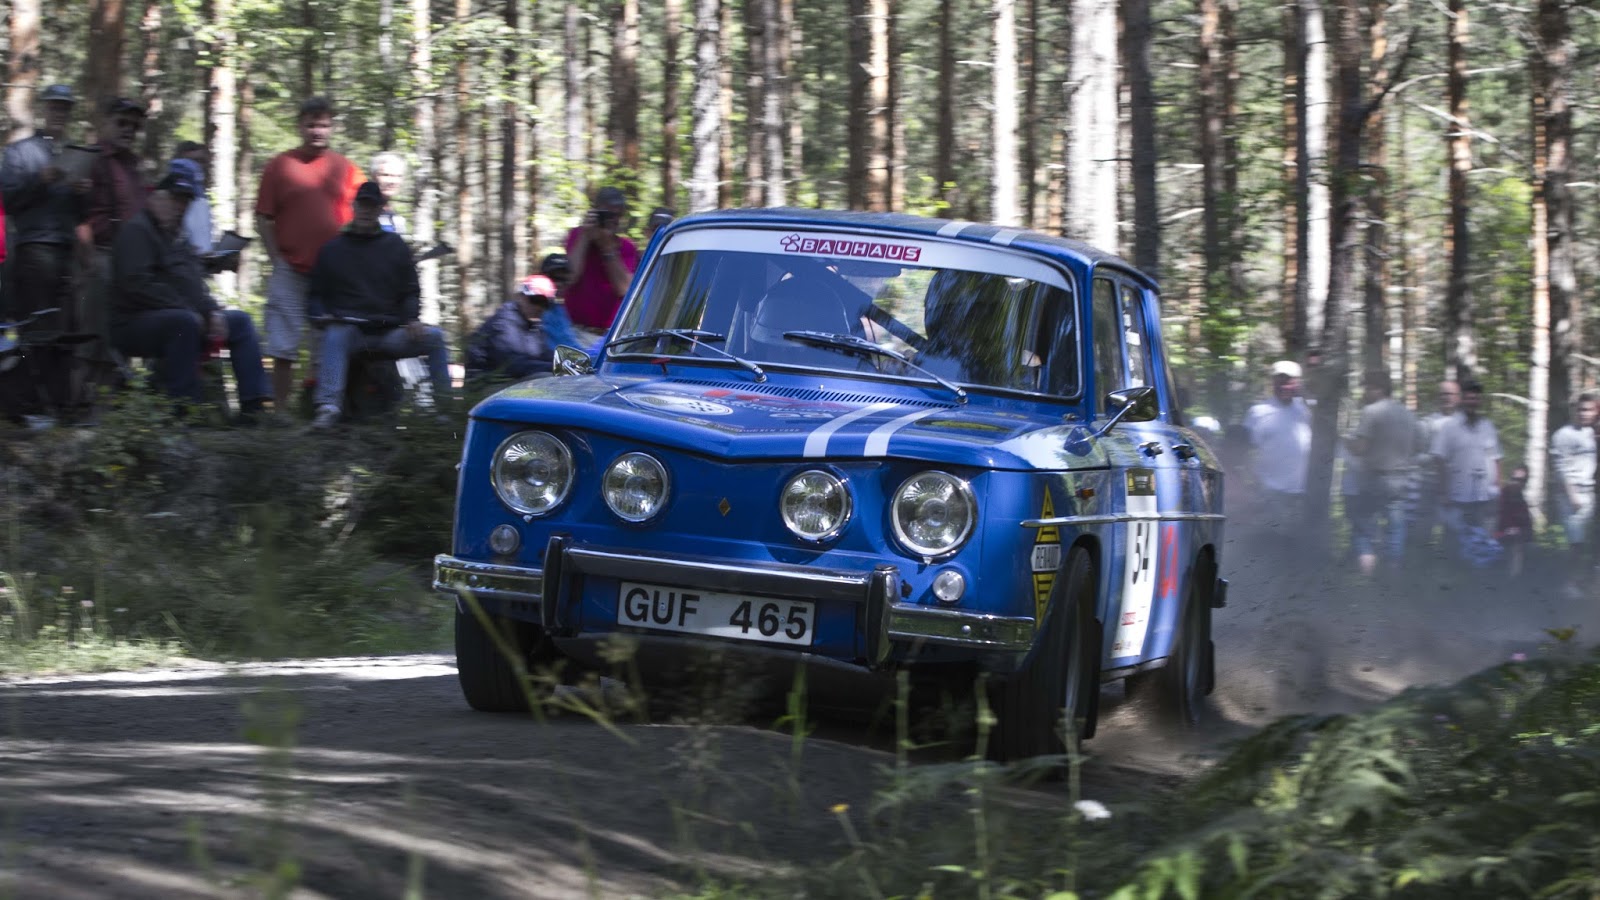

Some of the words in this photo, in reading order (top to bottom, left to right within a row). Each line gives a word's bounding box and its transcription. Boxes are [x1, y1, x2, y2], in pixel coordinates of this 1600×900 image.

[801, 238, 921, 261] BAUHAUS
[1132, 522, 1150, 585] 54
[624, 587, 700, 627] GUF
[729, 600, 808, 640] 465
